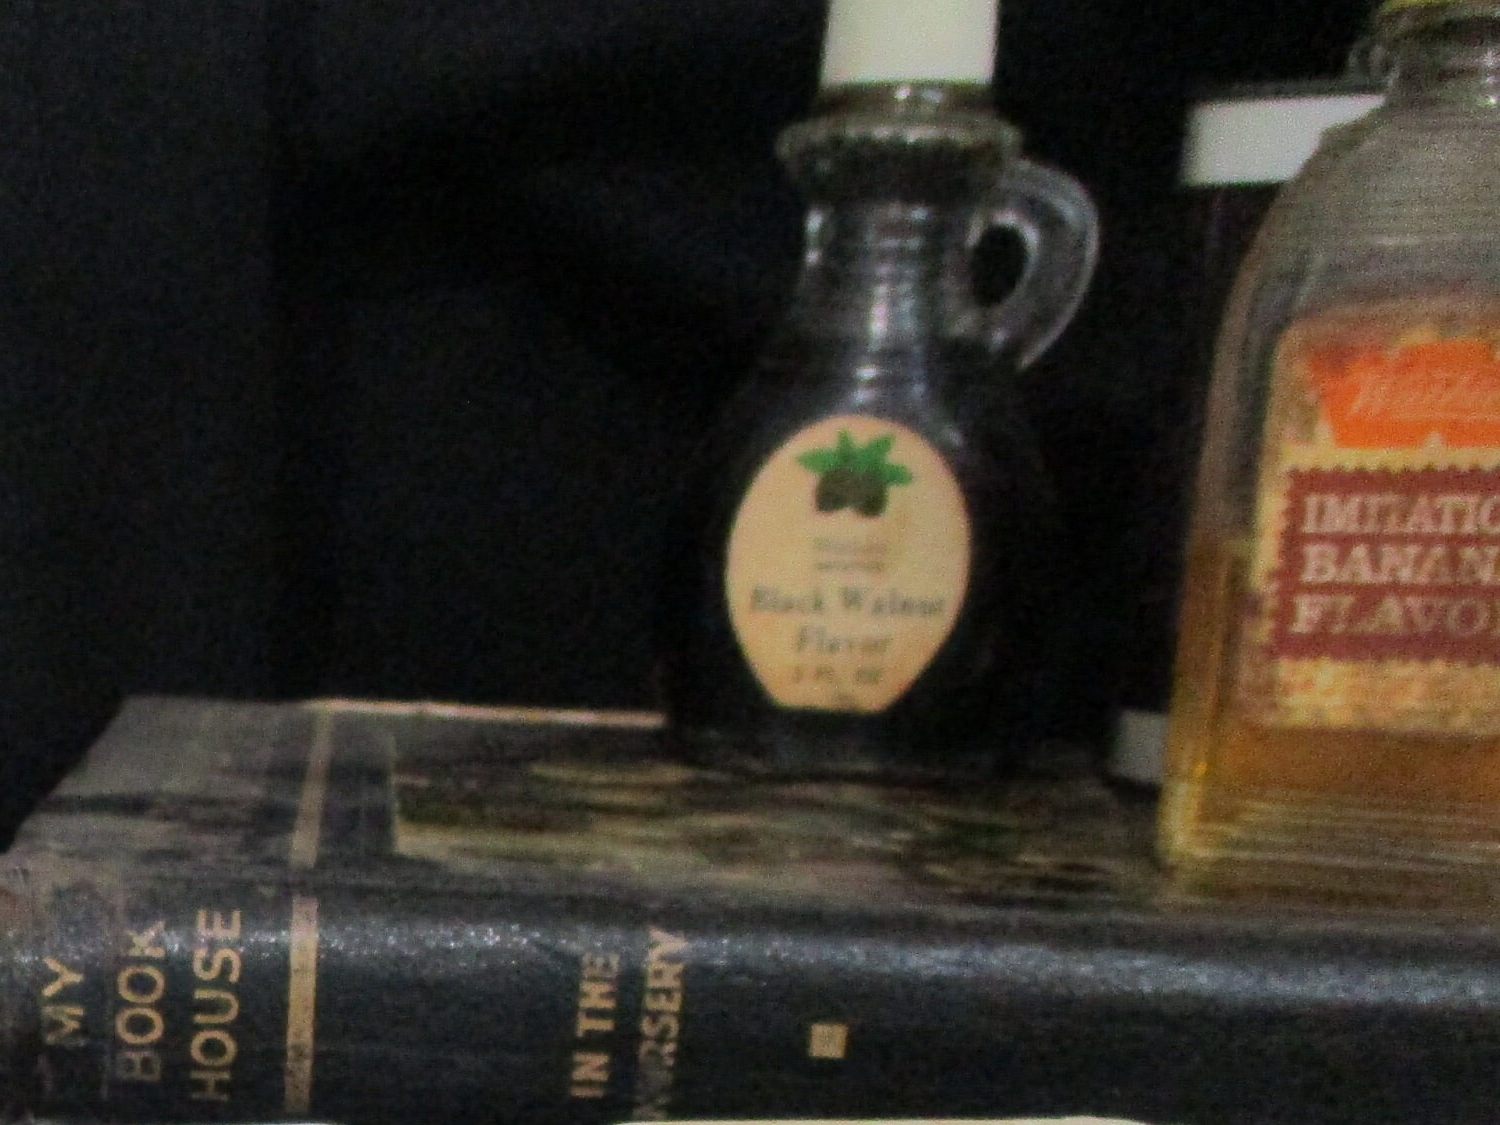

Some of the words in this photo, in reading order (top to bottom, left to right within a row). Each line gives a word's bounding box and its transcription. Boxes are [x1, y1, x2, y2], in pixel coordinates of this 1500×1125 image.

[1300, 544, 1500, 584] BANAN
[1289, 595, 1500, 637] FLAVO
[41, 956, 85, 1046] MY
[116, 920, 165, 1082] BOOK
[190, 909, 242, 1101] HOUSE
[575, 953, 620, 1037] THE
[569, 1051, 611, 1098] IN
